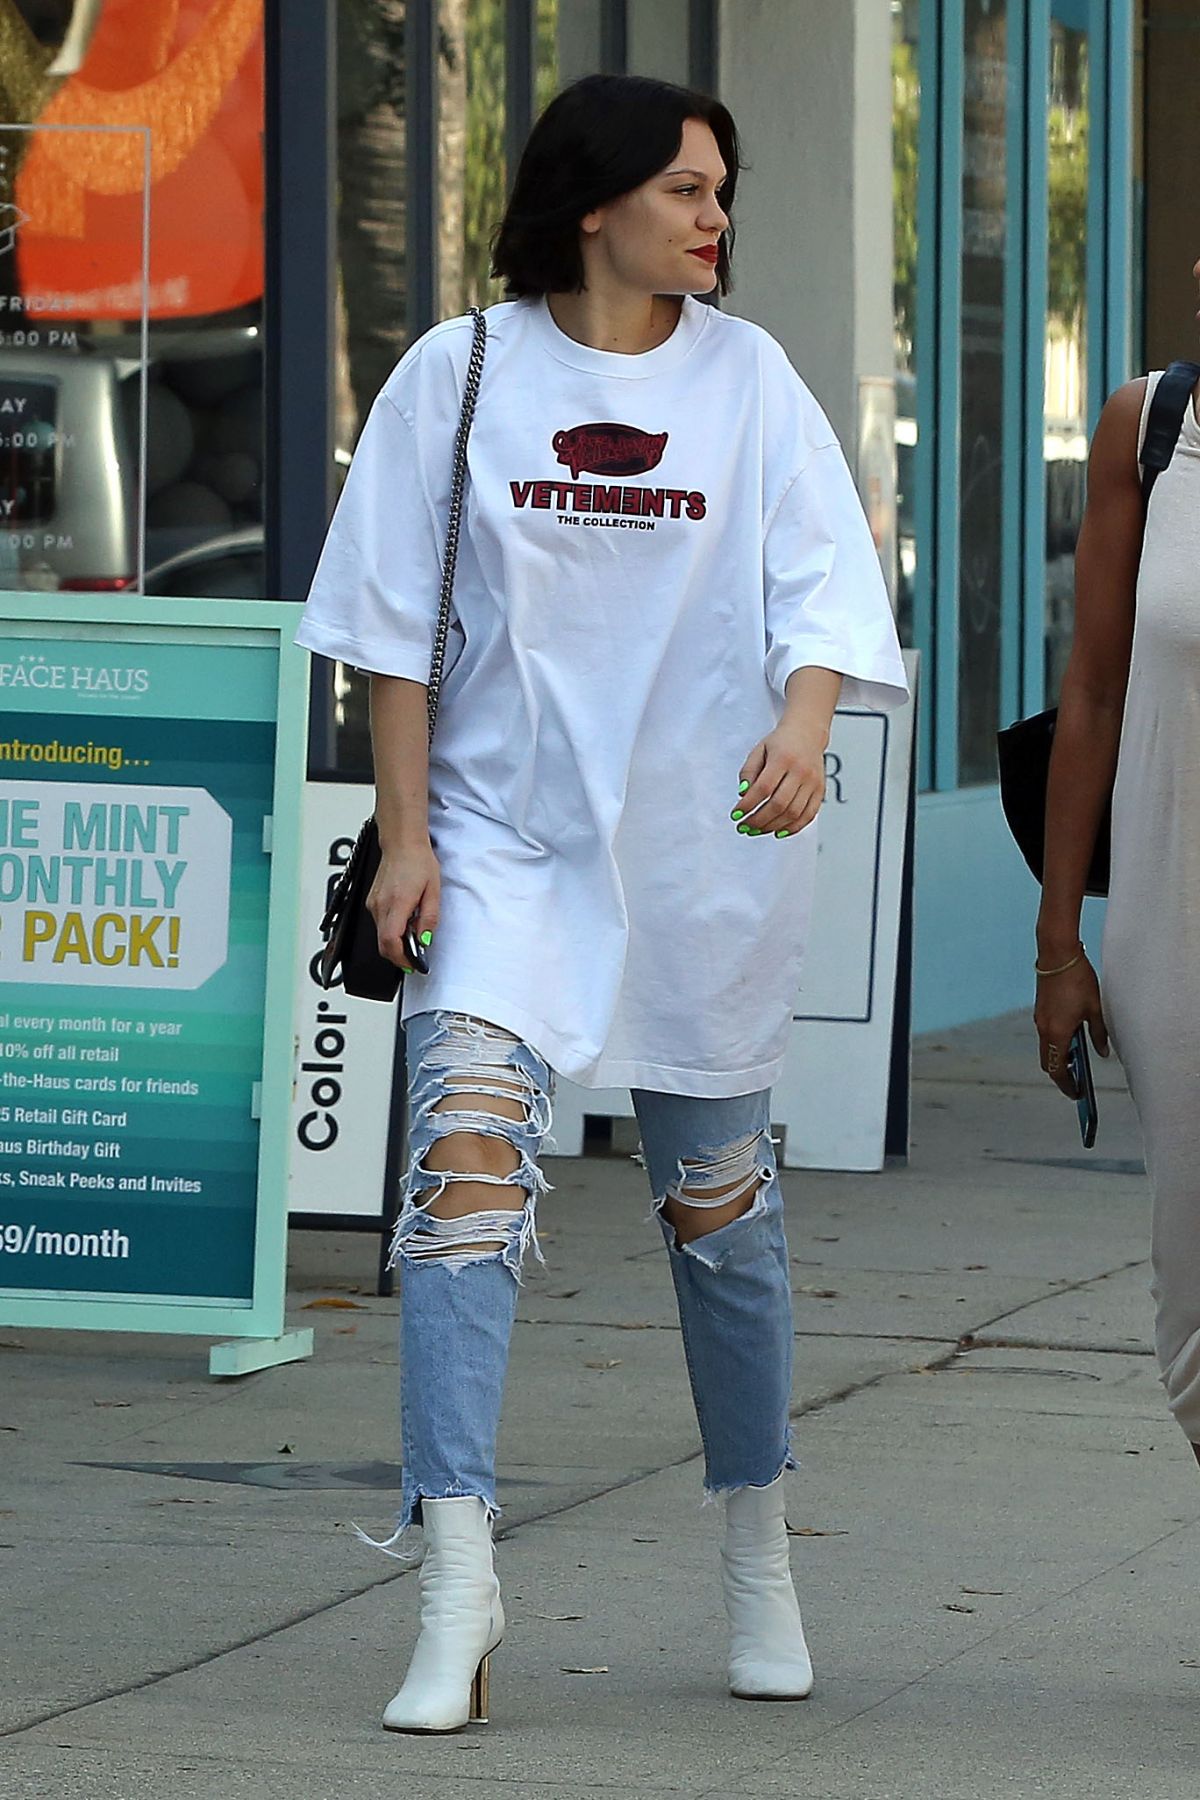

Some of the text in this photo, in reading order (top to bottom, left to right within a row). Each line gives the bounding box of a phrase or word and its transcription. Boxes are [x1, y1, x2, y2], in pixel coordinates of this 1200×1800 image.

[49, 331, 77, 346] PM
[509, 480, 707, 520] VETEMENTS
[557, 515, 656, 531] THE COLLECTION
[44, 534, 74, 550] PM
[0, 663, 149, 692] FACE HAUS
[63, 801, 190, 853] MINT
[0, 853, 188, 909] ONTHLY
[23, 910, 181, 968] PACK!
[14, 1016, 54, 1033] every
[59, 1017, 106, 1032] month
[111, 1018, 132, 1033] for
[136, 1022, 145, 1034] a
[149, 1022, 183, 1037] year
[33, 1044, 54, 1060] off
[58, 1045, 76, 1060] all
[80, 1047, 119, 1062] retail
[75, 1076, 117, 1092] cards
[121, 1077, 142, 1093] for
[146, 1078, 199, 1096] friends
[297, 1002, 348, 1152] Color
[15, 1107, 57, 1123] Retail
[61, 1109, 88, 1125] Gift
[92, 1110, 127, 1127] Card
[26, 1139, 90, 1160] Birthday
[94, 1141, 121, 1159] Gift
[19, 1170, 66, 1188] Sneak
[70, 1172, 115, 1190] Peeks
[118, 1176, 147, 1191] and
[151, 1176, 202, 1193] Invites
[0, 1224, 129, 1259] 9/month
